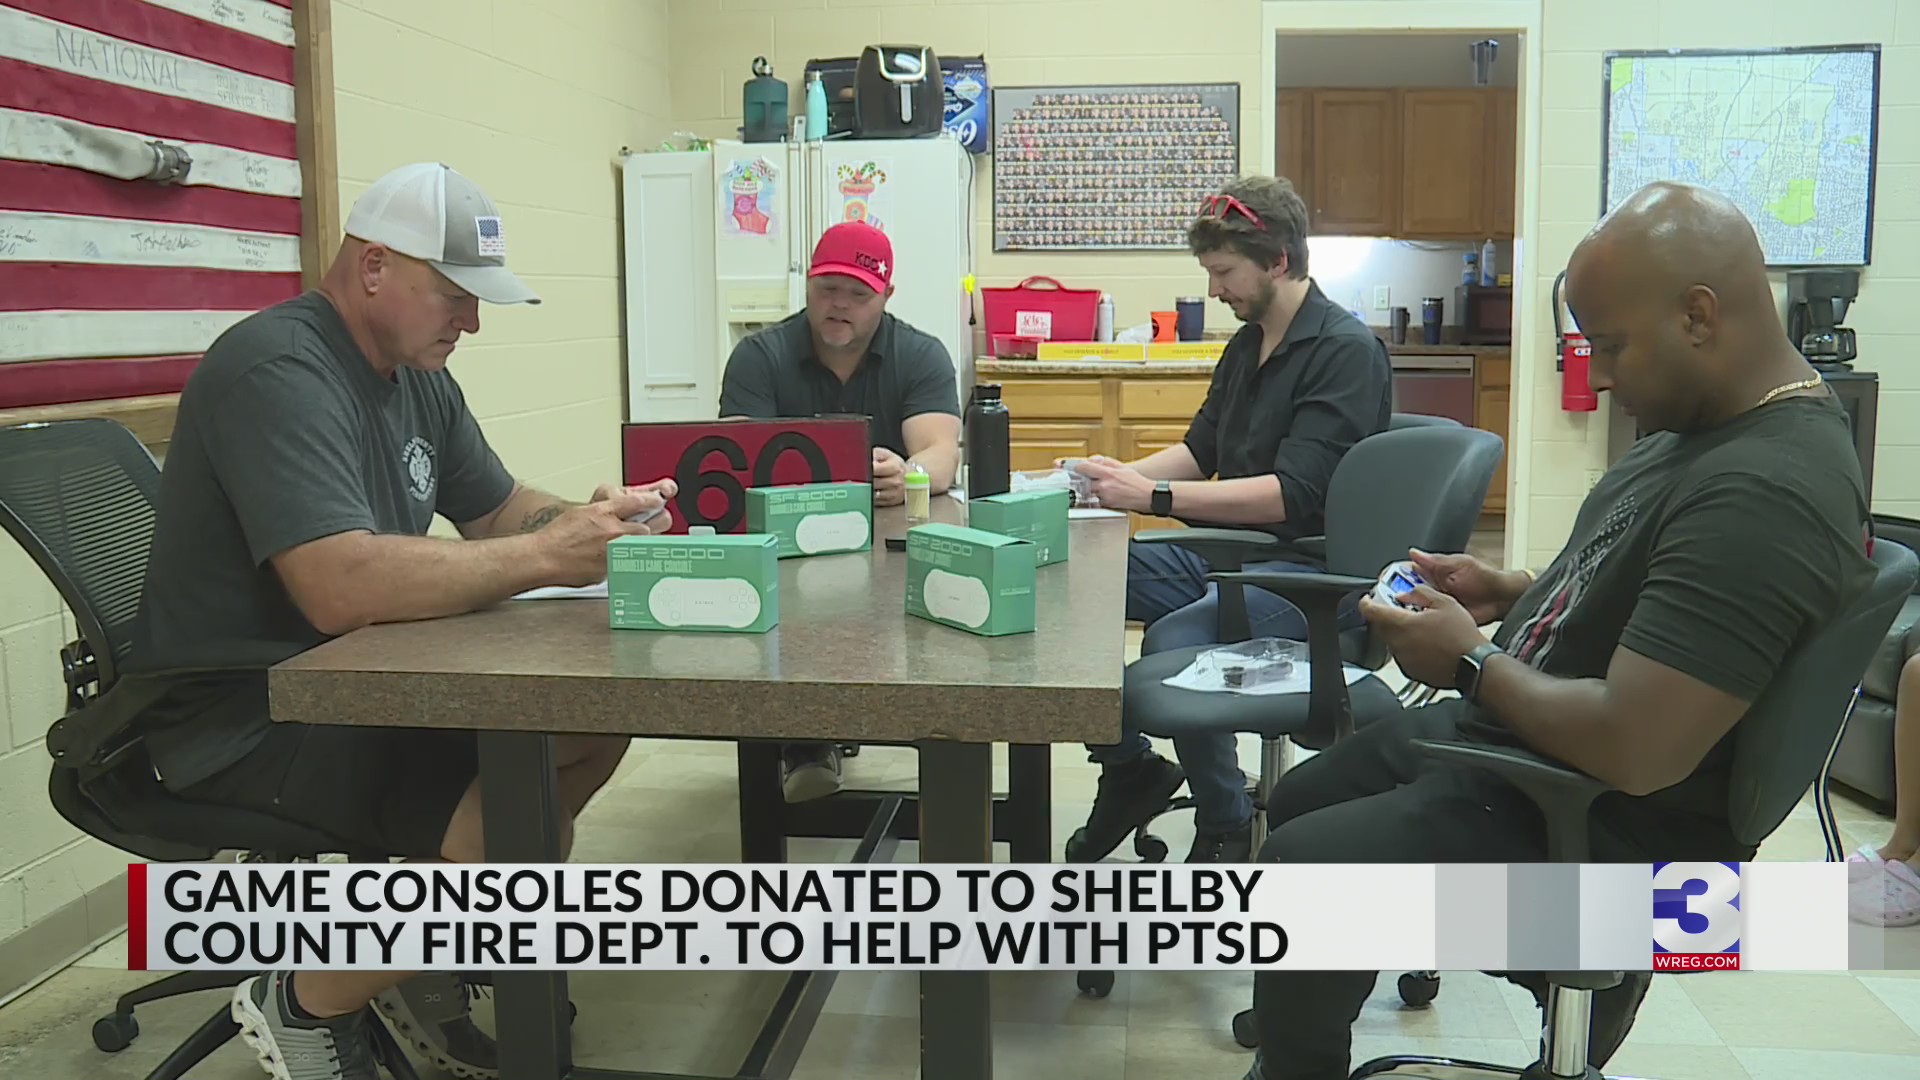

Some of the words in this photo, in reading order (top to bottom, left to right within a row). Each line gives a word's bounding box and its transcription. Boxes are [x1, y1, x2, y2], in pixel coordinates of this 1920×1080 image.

[55, 28, 187, 93] NATIONAL
[675, 431, 832, 533] 60
[797, 489, 848, 502] 2000
[612, 547, 648, 559] SF
[652, 547, 725, 560] 2000
[930, 538, 973, 557] 2000
